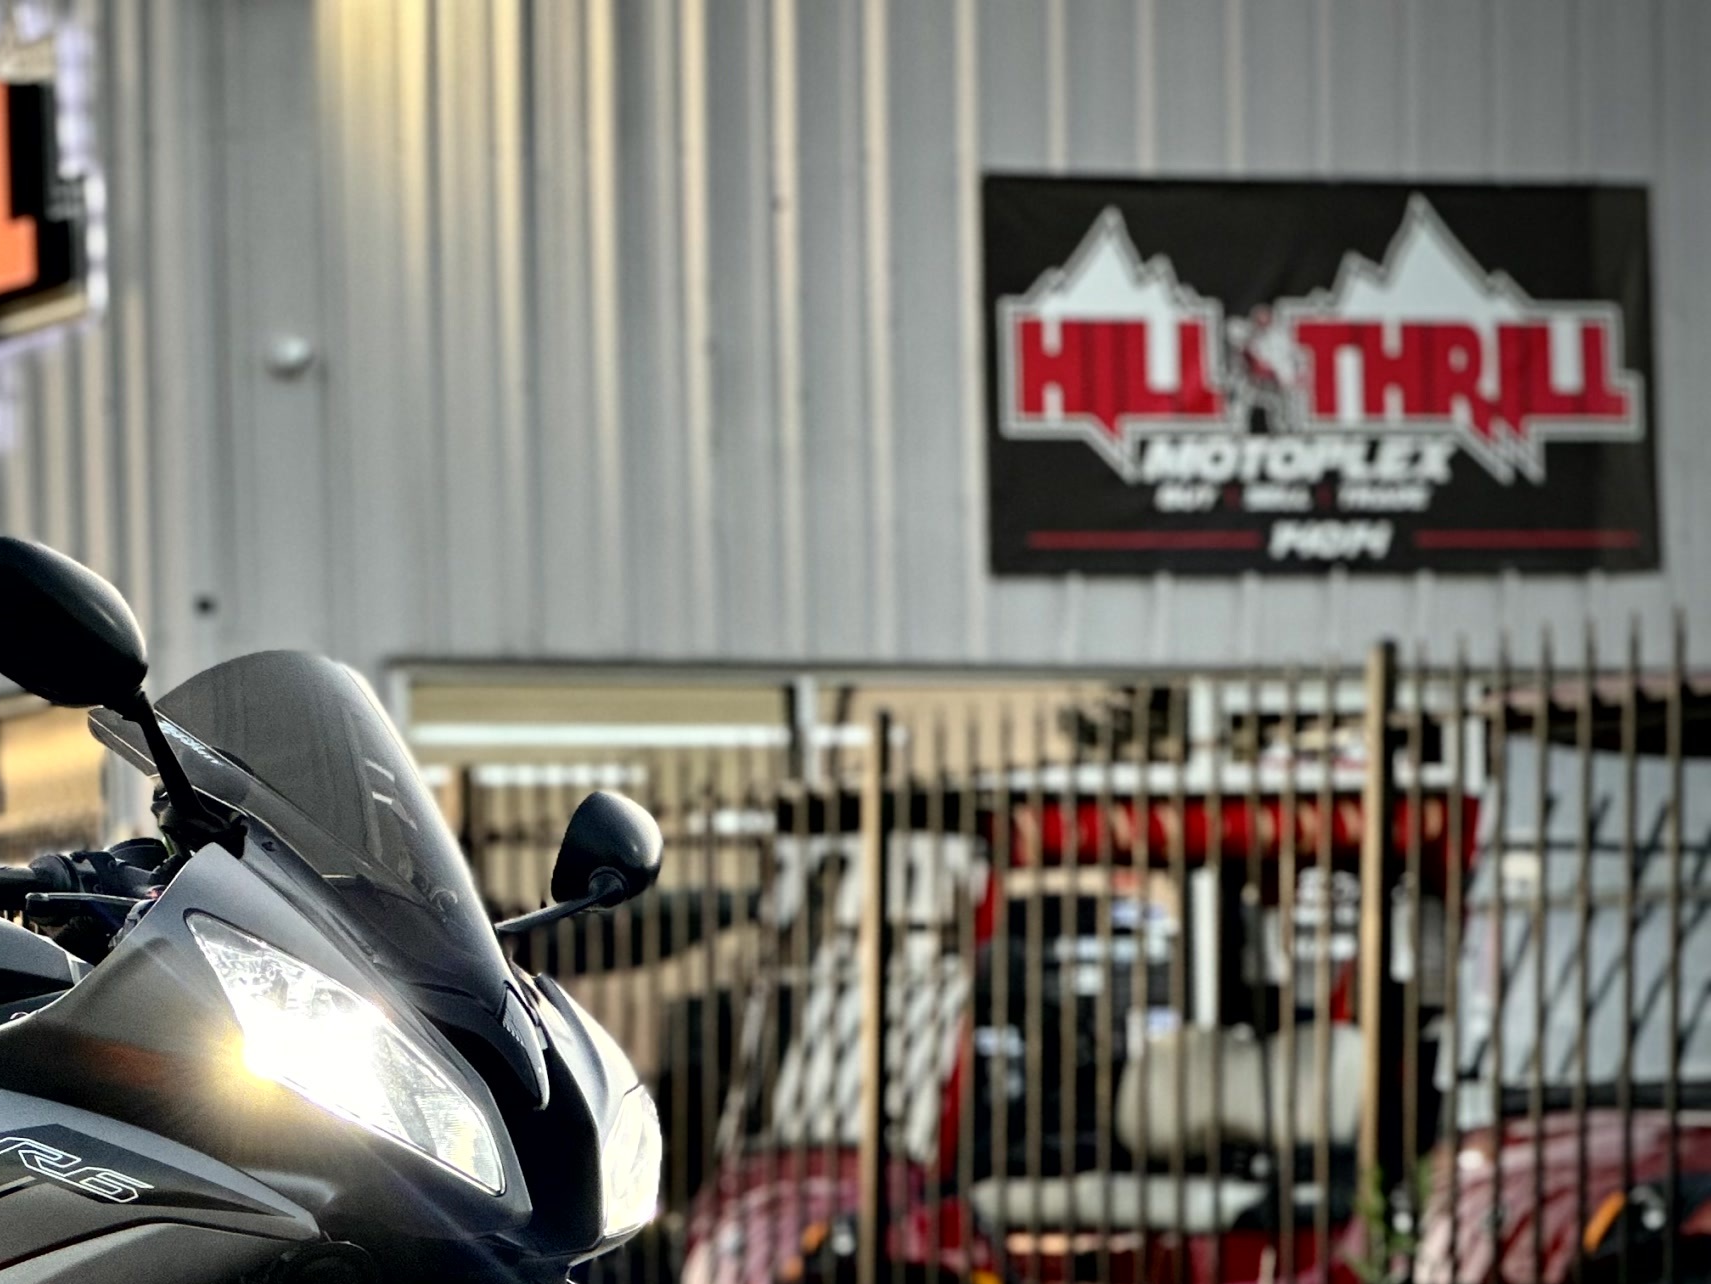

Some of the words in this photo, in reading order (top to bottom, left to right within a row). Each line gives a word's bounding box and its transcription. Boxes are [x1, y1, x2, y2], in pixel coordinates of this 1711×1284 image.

[1016, 319, 1223, 440] HILL
[1296, 320, 1628, 441] THRILL
[1142, 435, 1456, 484] MOTOPLEX
